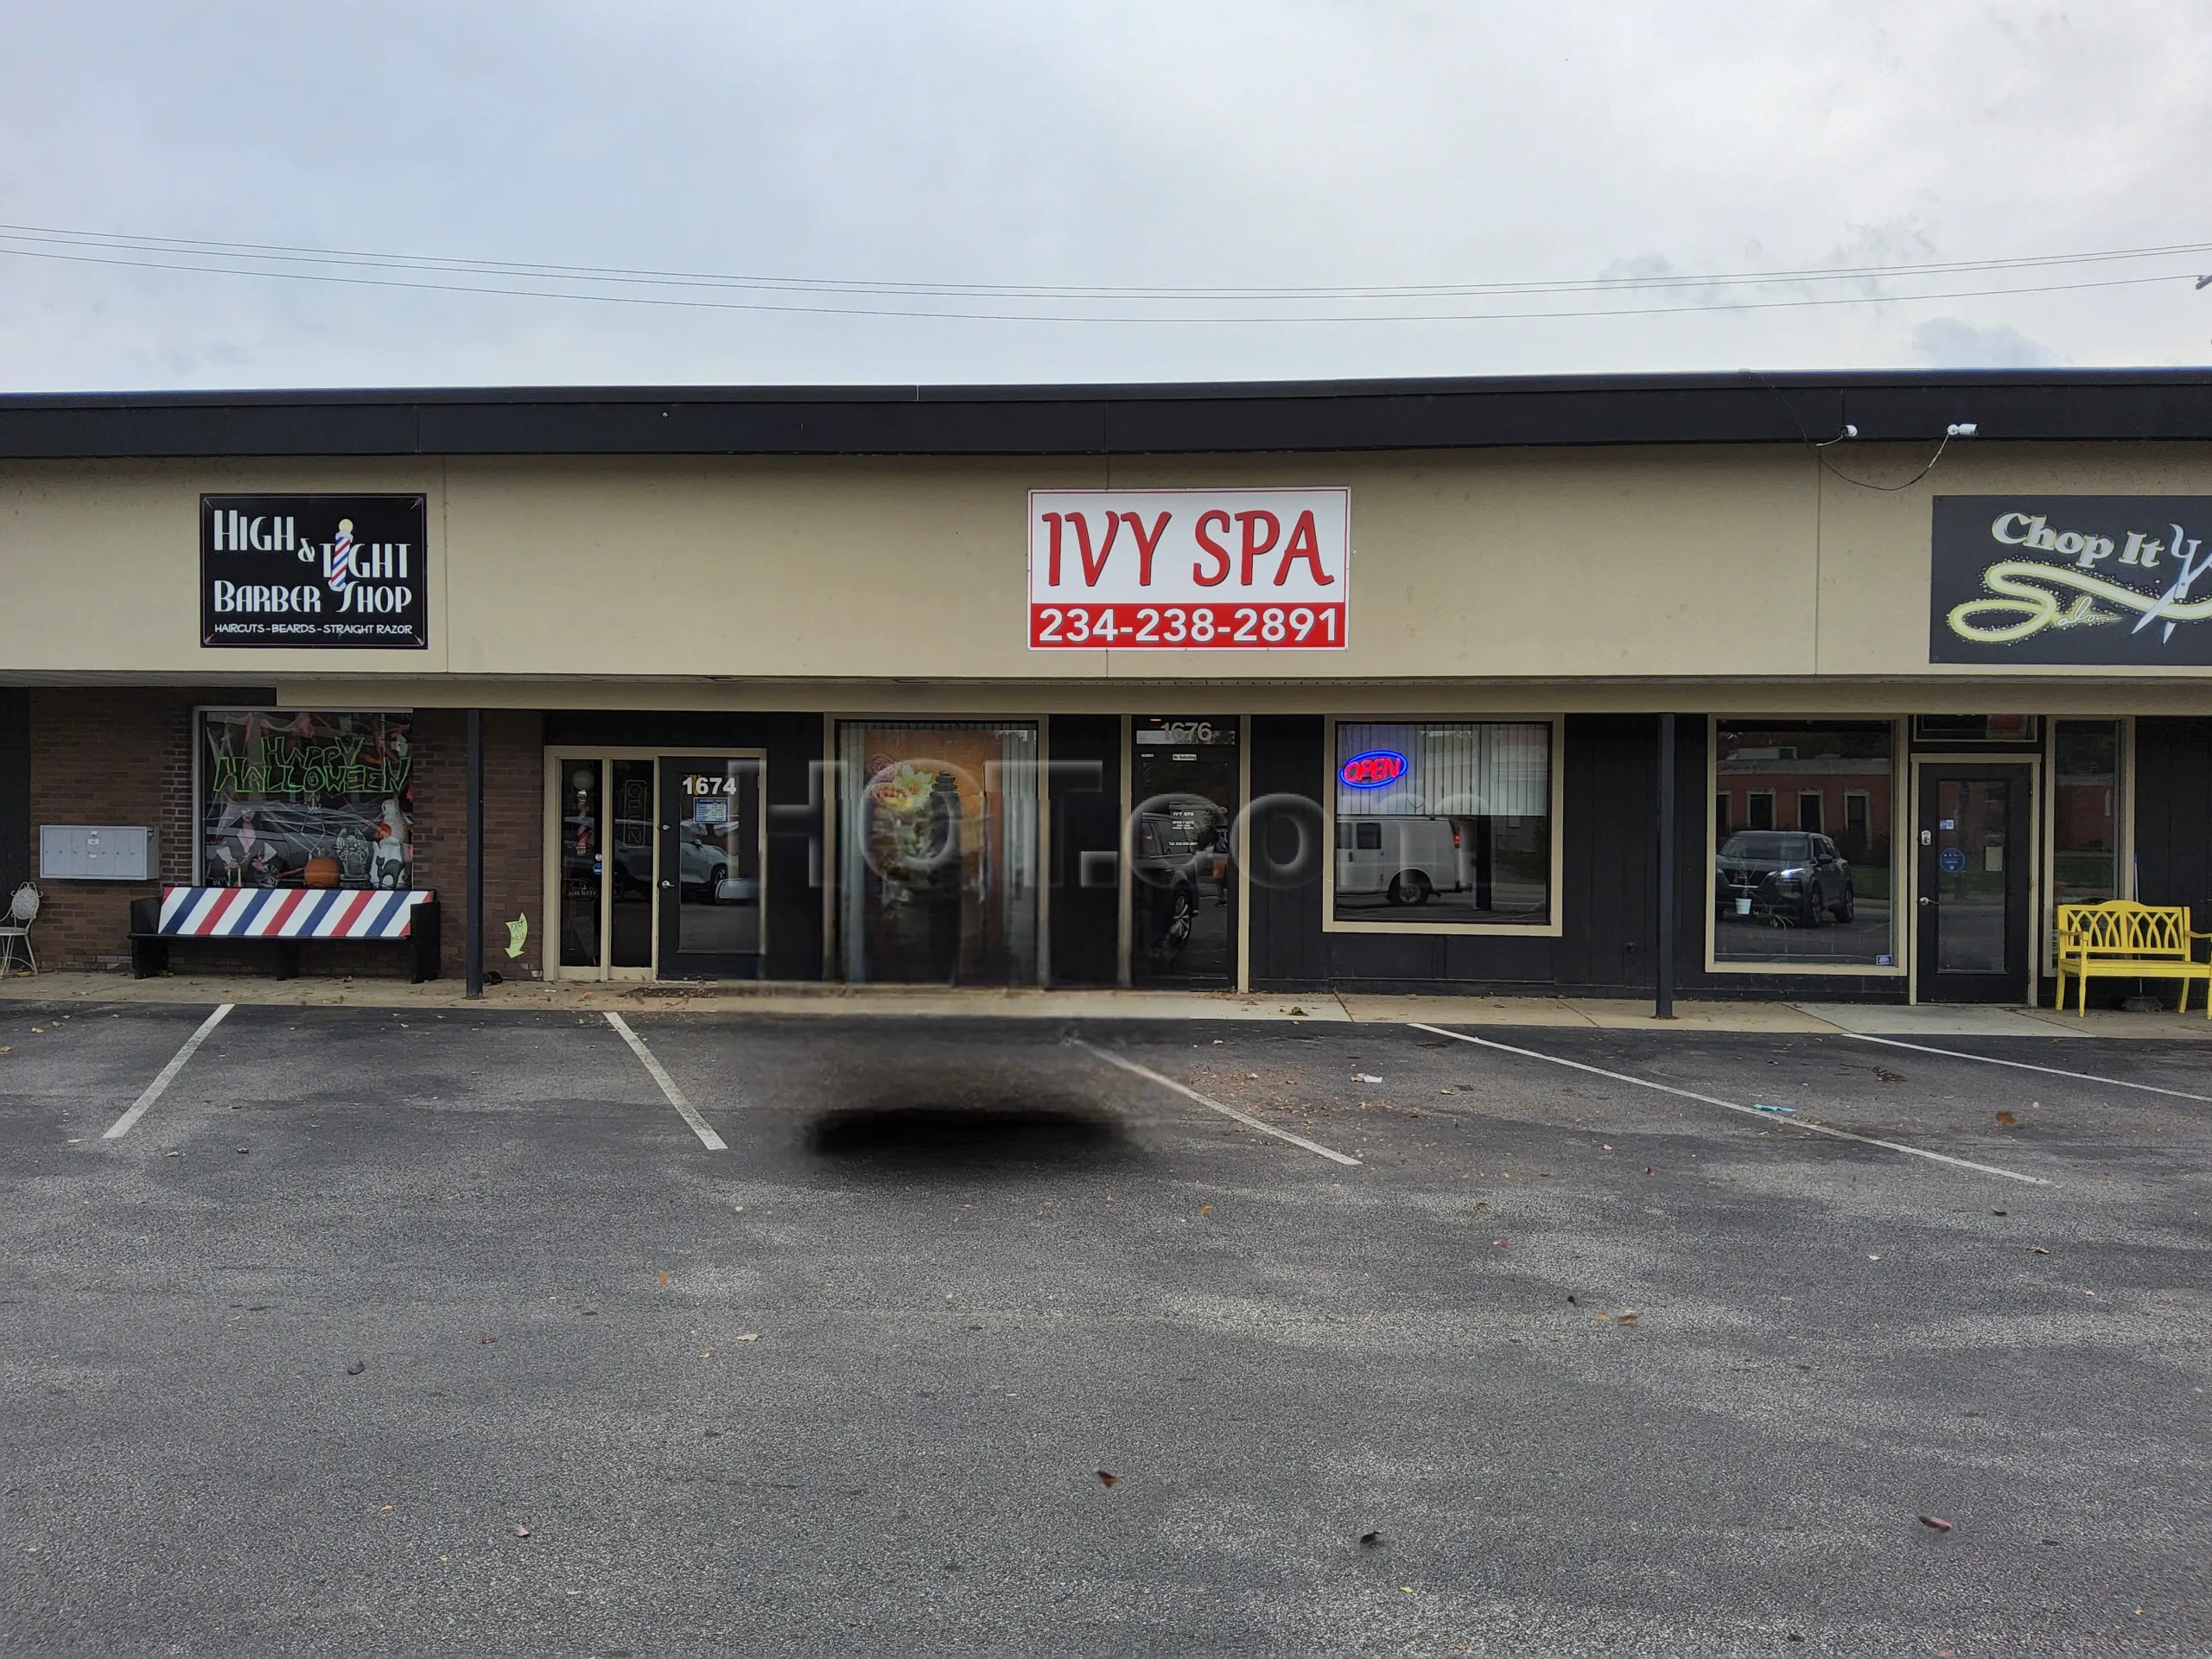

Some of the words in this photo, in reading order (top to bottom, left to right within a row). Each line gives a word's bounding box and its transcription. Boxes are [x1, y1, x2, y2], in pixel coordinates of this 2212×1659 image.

[213, 509, 295, 550] HIGH
[297, 537, 315, 562] &
[1041, 511, 1173, 587] IVY
[1192, 510, 1335, 588] SPA
[1991, 511, 2115, 569] Chop
[2118, 530, 2165, 568] It
[214, 580, 321, 613] BARBER
[335, 581, 412, 613] SHOP
[376, 624, 413, 635] RAZOR
[1039, 607, 1338, 643] 234-238-2891
[1160, 722, 1212, 741] 1676
[261, 735, 365, 767] HAPPY
[213, 756, 411, 793] HALLOWEEN
[683, 777, 737, 795] 1674
[1344, 757, 1402, 783] OPEN
